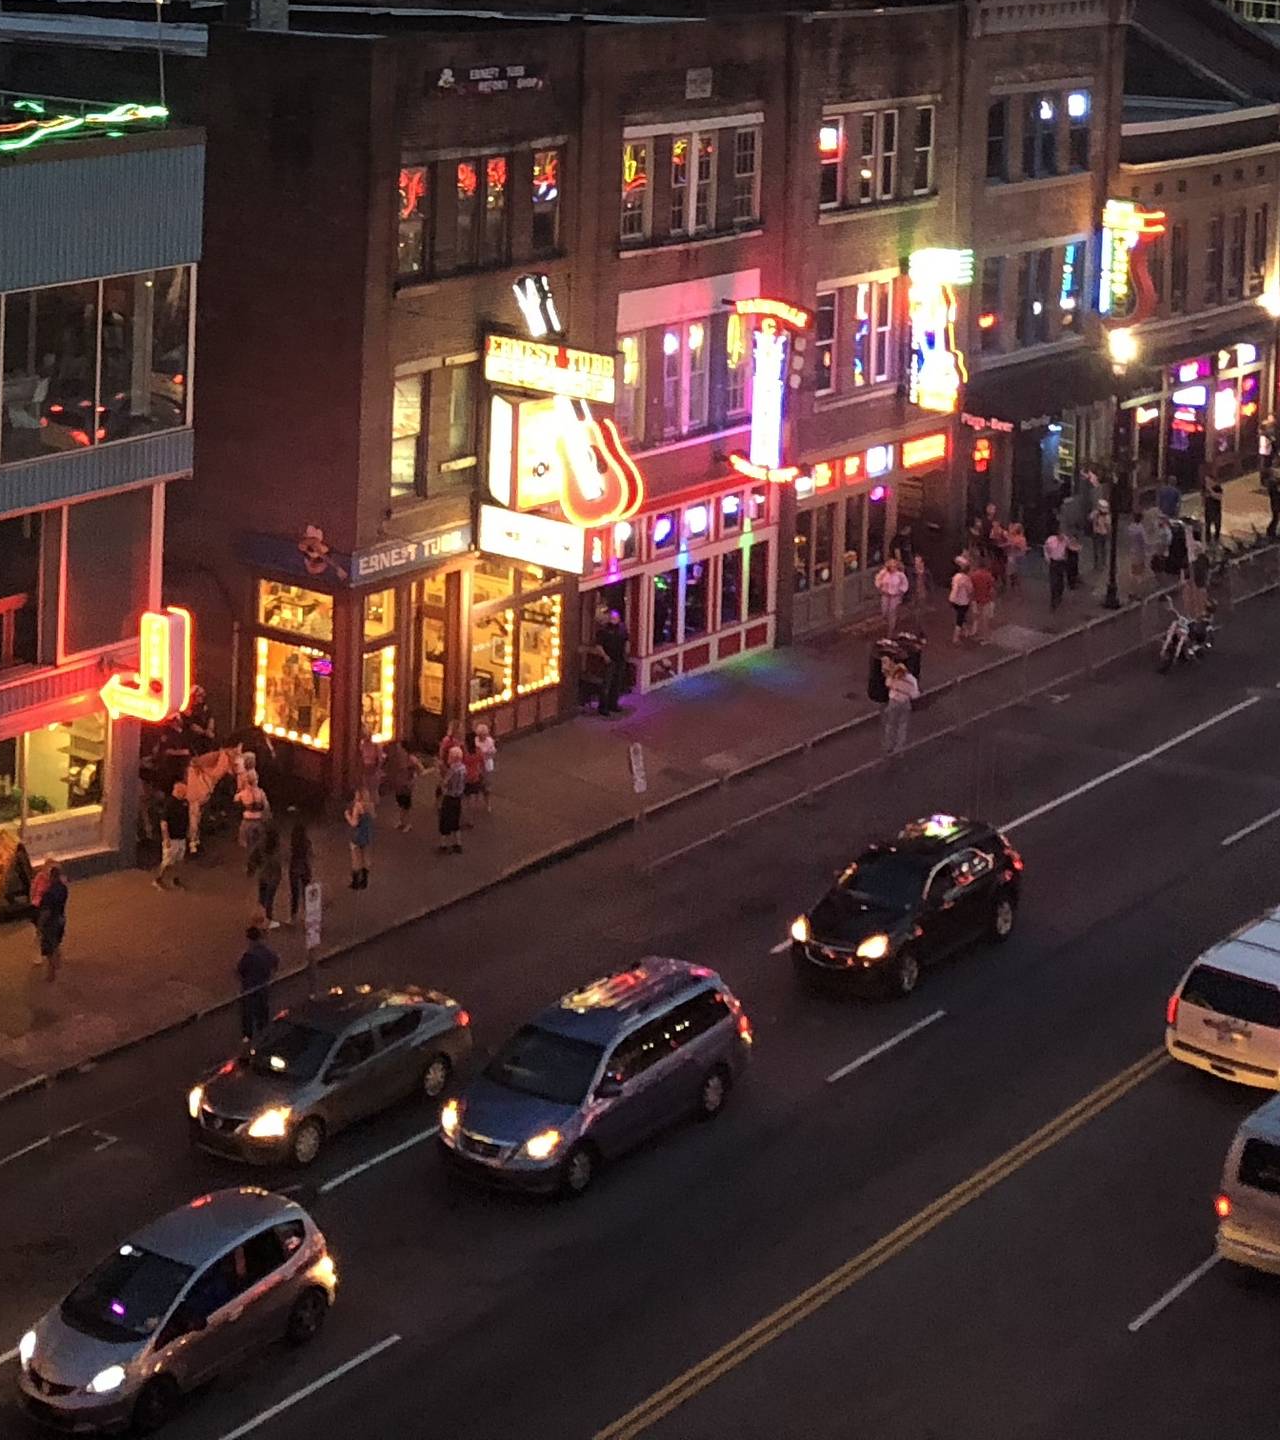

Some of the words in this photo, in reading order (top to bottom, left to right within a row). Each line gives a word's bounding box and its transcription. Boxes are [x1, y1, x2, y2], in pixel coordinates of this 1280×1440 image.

[488, 336, 559, 369] ERNEST
[566, 348, 615, 378] TUBB
[358, 543, 418, 576] ERNEST
